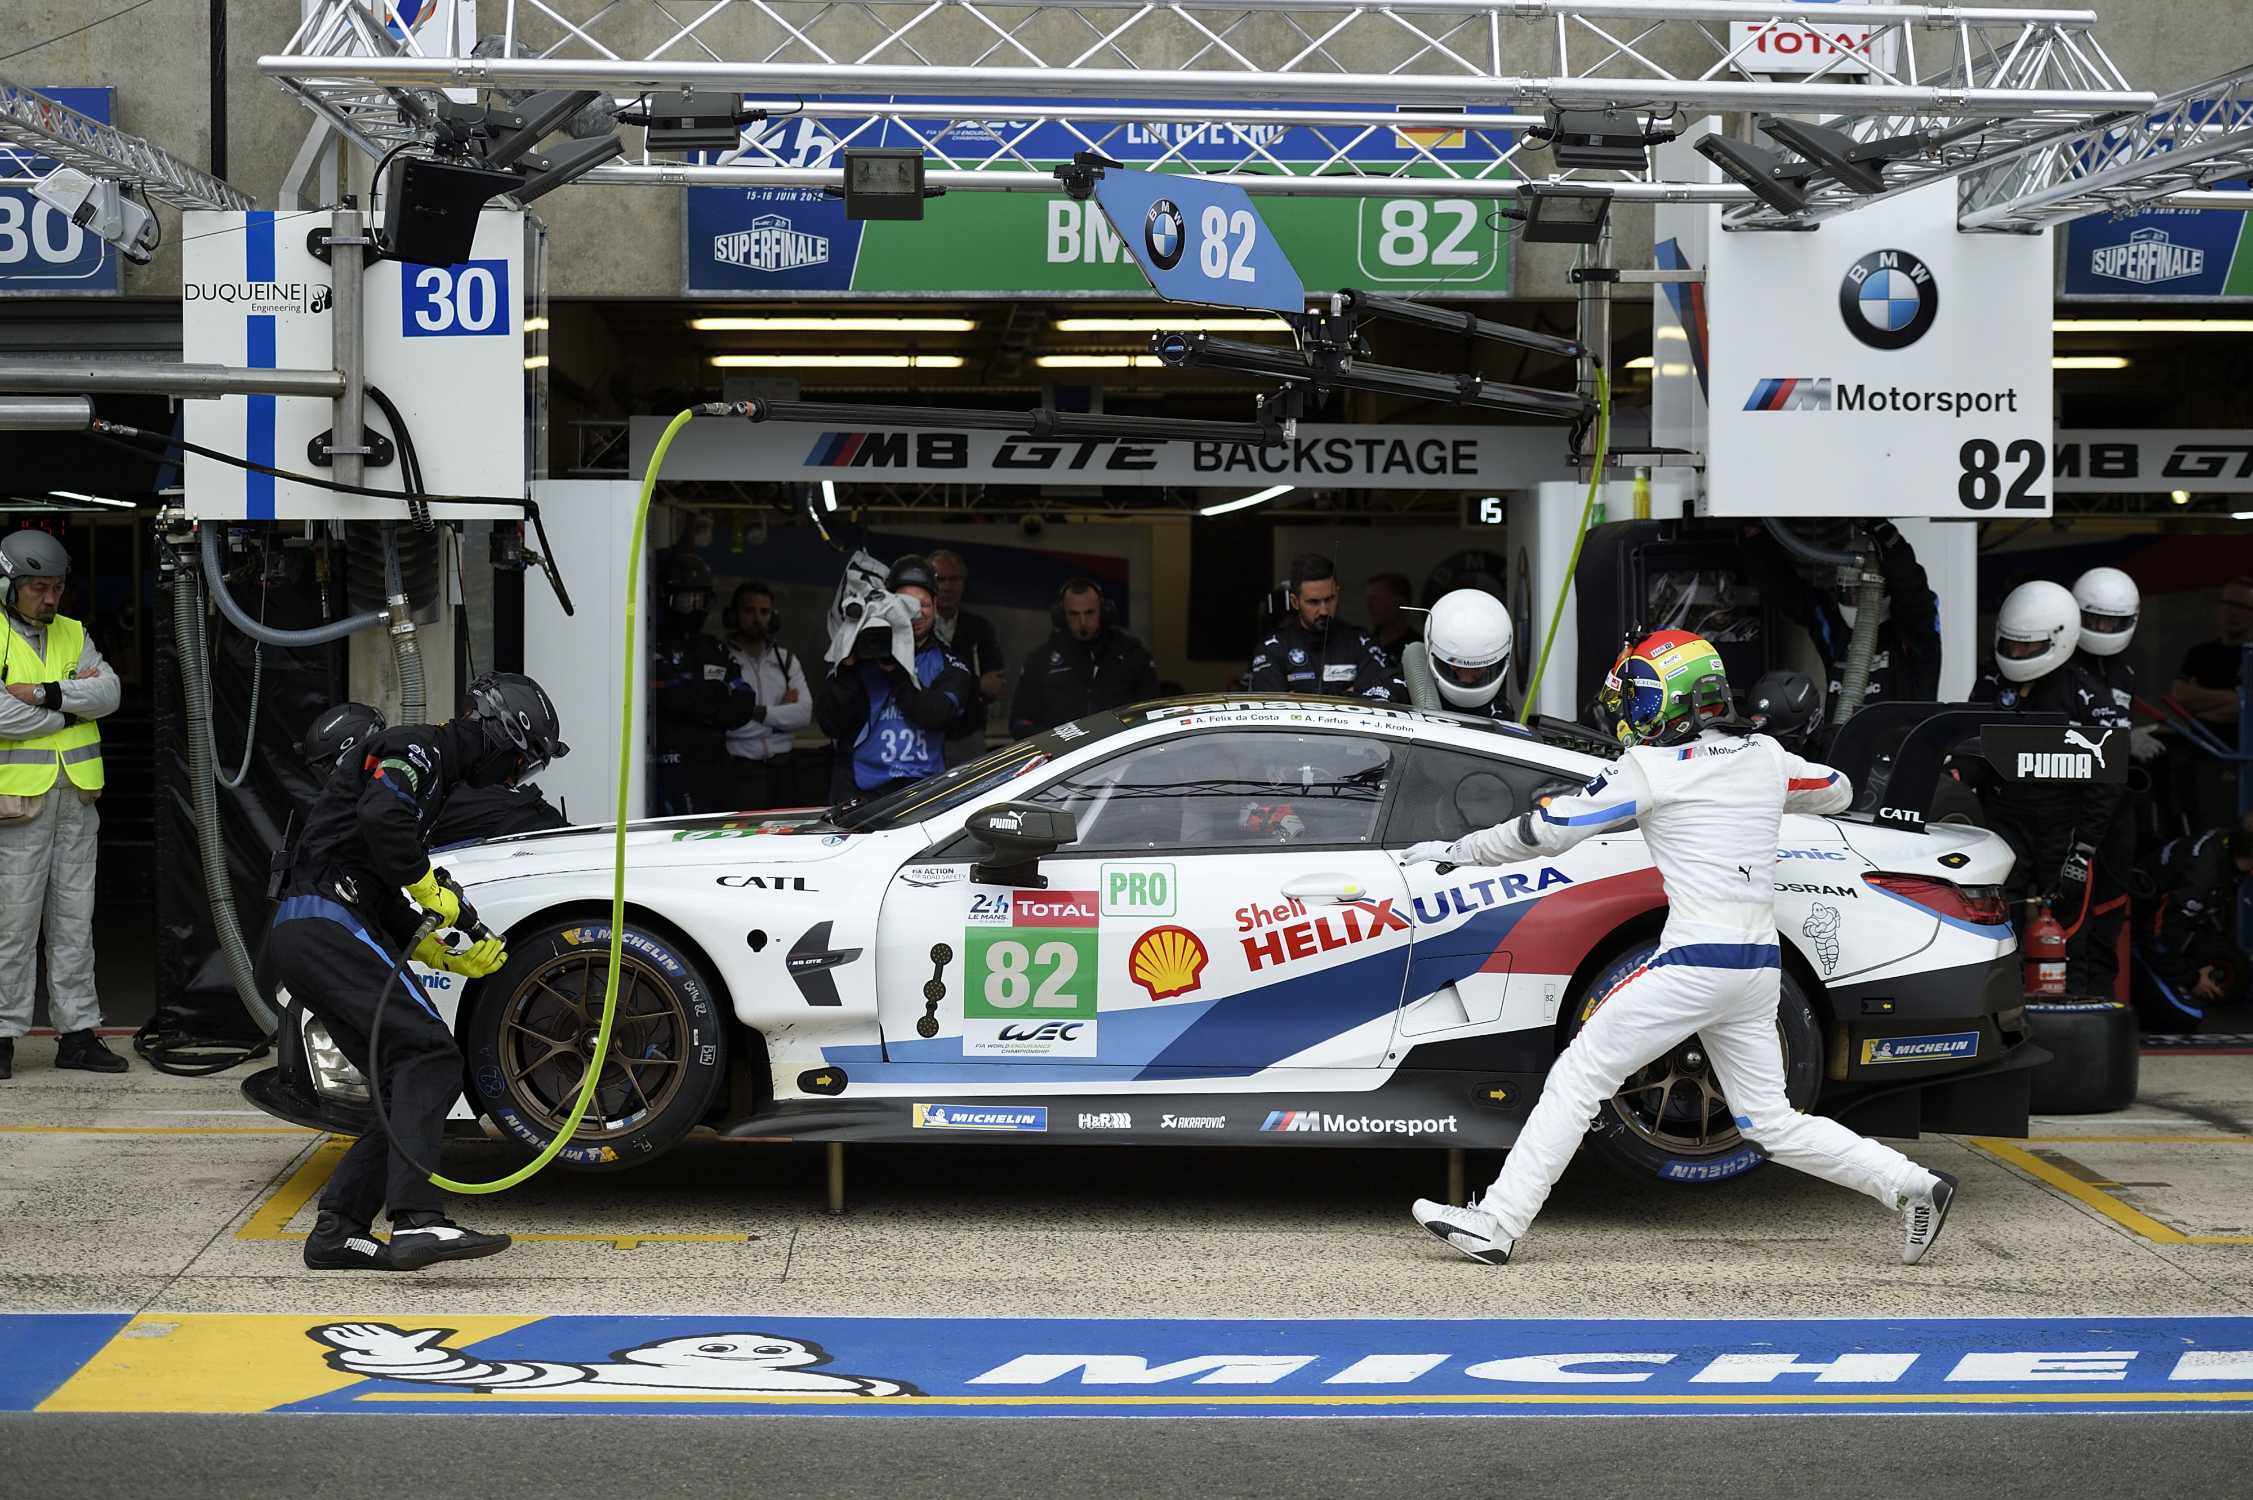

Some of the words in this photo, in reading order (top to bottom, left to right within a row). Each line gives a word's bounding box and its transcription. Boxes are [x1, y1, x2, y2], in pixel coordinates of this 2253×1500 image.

[775, 191, 798, 201] JUIN
[1047, 200, 1134, 264] BM
[1201, 205, 1256, 282] 82
[1379, 200, 1478, 266] 82
[716, 230, 827, 269] SUPERFINALE
[2094, 243, 2202, 281] SUPERFINALE
[184, 283, 301, 303] DUQUEINE
[415, 266, 497, 332] 30
[251, 303, 301, 313] Engineering
[1837, 383, 2017, 418] Motorsport
[850, 433, 968, 469] M8
[992, 435, 1160, 470] GTE
[1192, 437, 1478, 475] BACKSTAGE
[1957, 438, 2047, 510] 82
[1235, 713, 1248, 721] da
[1251, 713, 1280, 721] Costa
[1318, 716, 1349, 725] Farfus
[1385, 722, 1414, 733] Krohn
[881, 729, 929, 763] 325
[2017, 752, 2092, 779] PUMA
[989, 817, 1018, 831] PUMA
[1880, 807, 1925, 824] CATL
[716, 876, 819, 892] CATL
[1110, 872, 1167, 906] PRO
[1774, 882, 1859, 899] OSRAM
[1016, 900, 1096, 917] TOTAL
[1235, 897, 1307, 933] Shell
[1240, 898, 1411, 973] HELIX
[1413, 866, 1575, 926] ULTRA
[597, 928, 680, 971] MCHELIN
[984, 941, 1079, 1009] 82
[998, 1021, 1085, 1041] WEC
[1895, 1040, 1969, 1056] MICHELIN
[950, 1113, 1037, 1124] MICHELIN
[1323, 1114, 1458, 1137] Motorsport
[504, 1114, 583, 1161] MIHELIN
[1669, 1151, 1762, 1179] ICHELIN
[344, 1237, 379, 1257] PUMA
[965, 1350, 2253, 1385] MICHE
